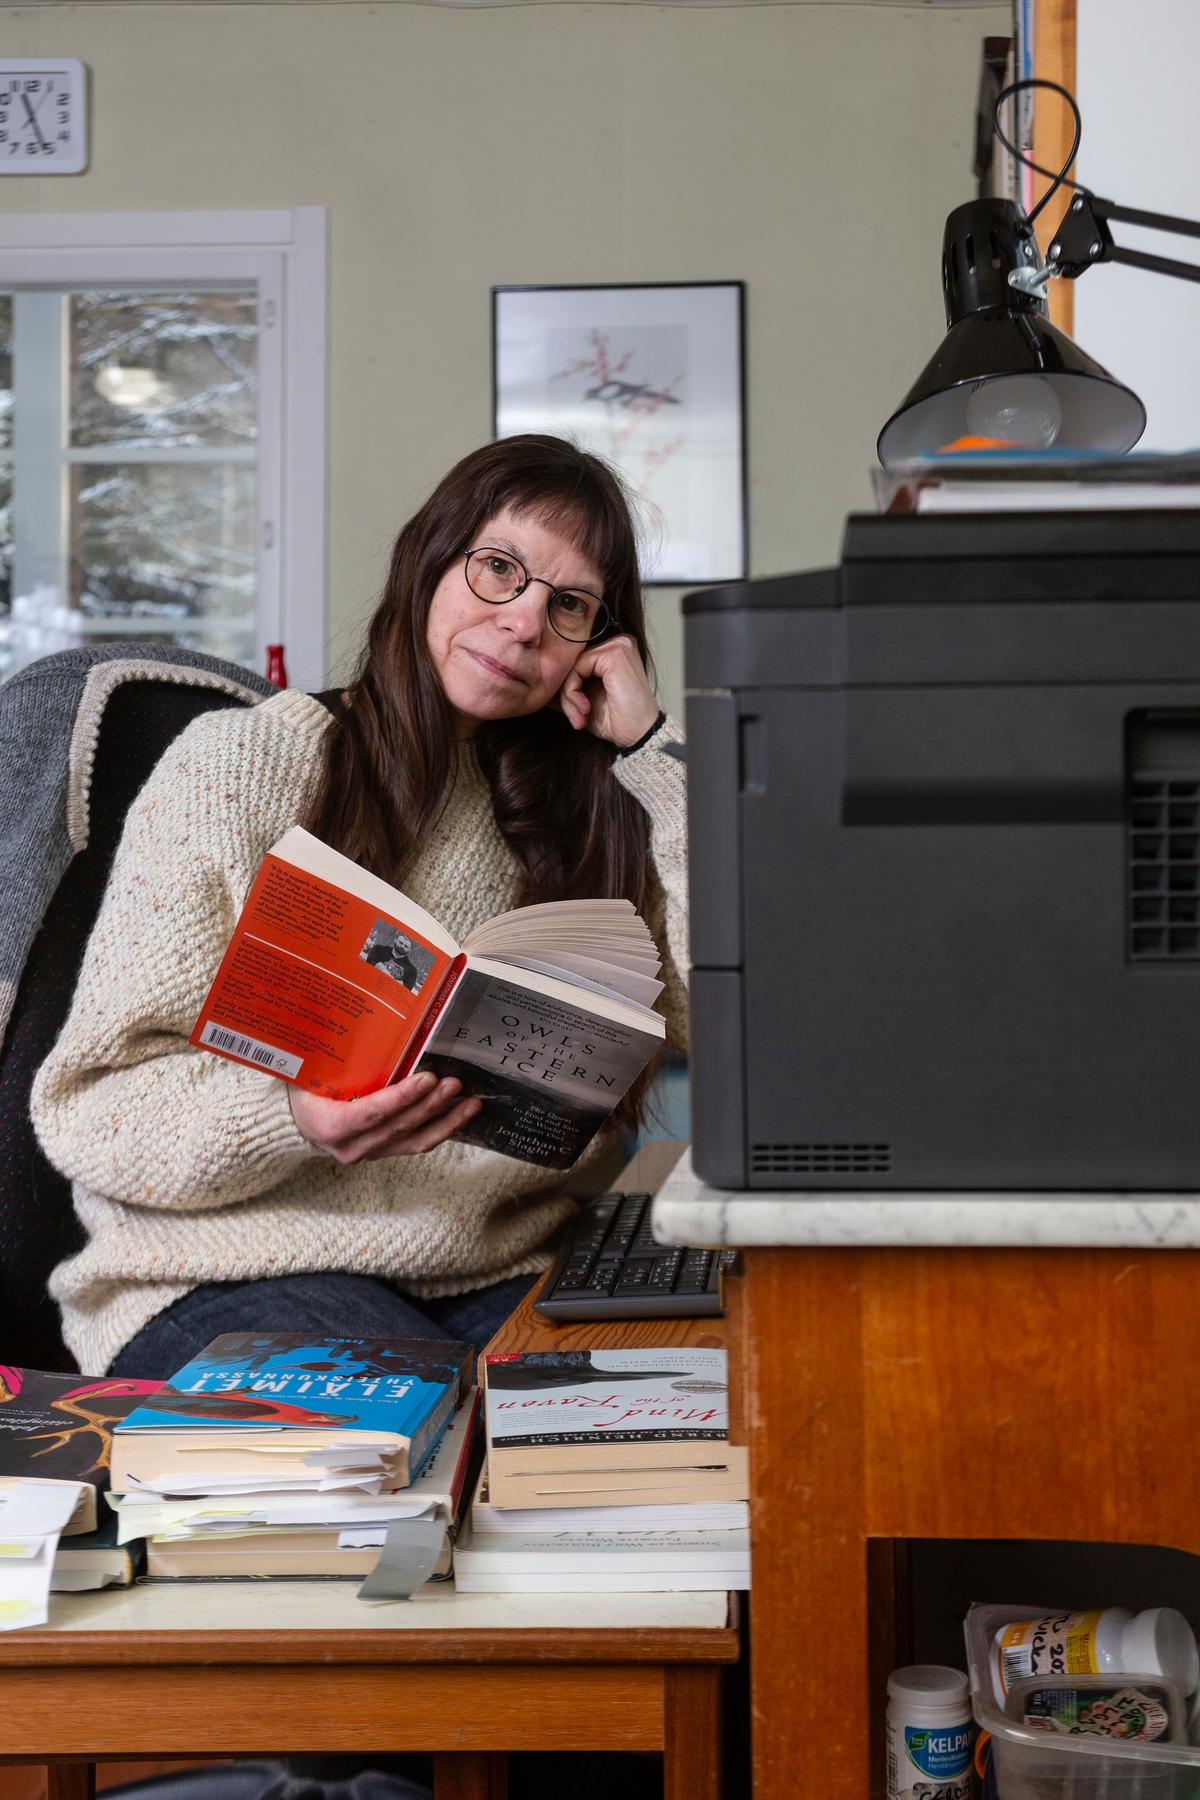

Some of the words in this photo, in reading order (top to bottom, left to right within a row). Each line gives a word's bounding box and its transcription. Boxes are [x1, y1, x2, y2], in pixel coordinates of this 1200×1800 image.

[57, 111, 70, 124] 3
[8, 142, 20, 154] 7
[263, 883, 277, 892] and
[277, 889, 291, 899] men
[292, 896, 311, 908] battle
[311, 905, 325, 915] with
[265, 876, 285, 890] world
[285, 886, 306, 900] where
[325, 905, 344, 918] tigers
[287, 872, 311, 888] superb
[311, 884, 342, 902] depiction
[341, 898, 349, 906] of
[301, 886, 323, 901] corner
[330, 900, 342, 910] the
[258, 894, 275, 905] each
[275, 902, 293, 914] other
[260, 888, 291, 906] relentless
[290, 902, 330, 924] environment
[329, 920, 344, 931] and
[299, 920, 325, 937] violence
[324, 932, 340, 944] and
[488, 993, 511, 1004] elusive
[512, 1001, 527, 1009] and
[527, 1006, 558, 1021] beautiful
[556, 1018, 585, 1031] creature
[505, 993, 519, 1002] and
[519, 999, 565, 1018] perseverance
[573, 1019, 596, 1030] search
[605, 1030, 617, 1038] this
[501, 1014, 596, 1055] OWLS
[585, 1017, 632, 1037] determination
[454, 1027, 616, 1088] EASTERN
[506, 1031, 528, 1042] OF
[540, 1042, 577, 1060] THE
[498, 1055, 556, 1082] ICE
[494, 1124, 558, 1151] Jonathan
[507, 1137, 550, 1159] Slaght
[180, 1380, 414, 1398] ELÄIMET
[202, 1372, 414, 1386] YHTEISKUNNASSA
[495, 1393, 625, 1412] Raven
[591, 1406, 728, 1426] Mind
[528, 1434, 641, 1442] HEINRICH
[654, 1431, 725, 1439] BERND
[928, 1730, 975, 1752] KELPA
